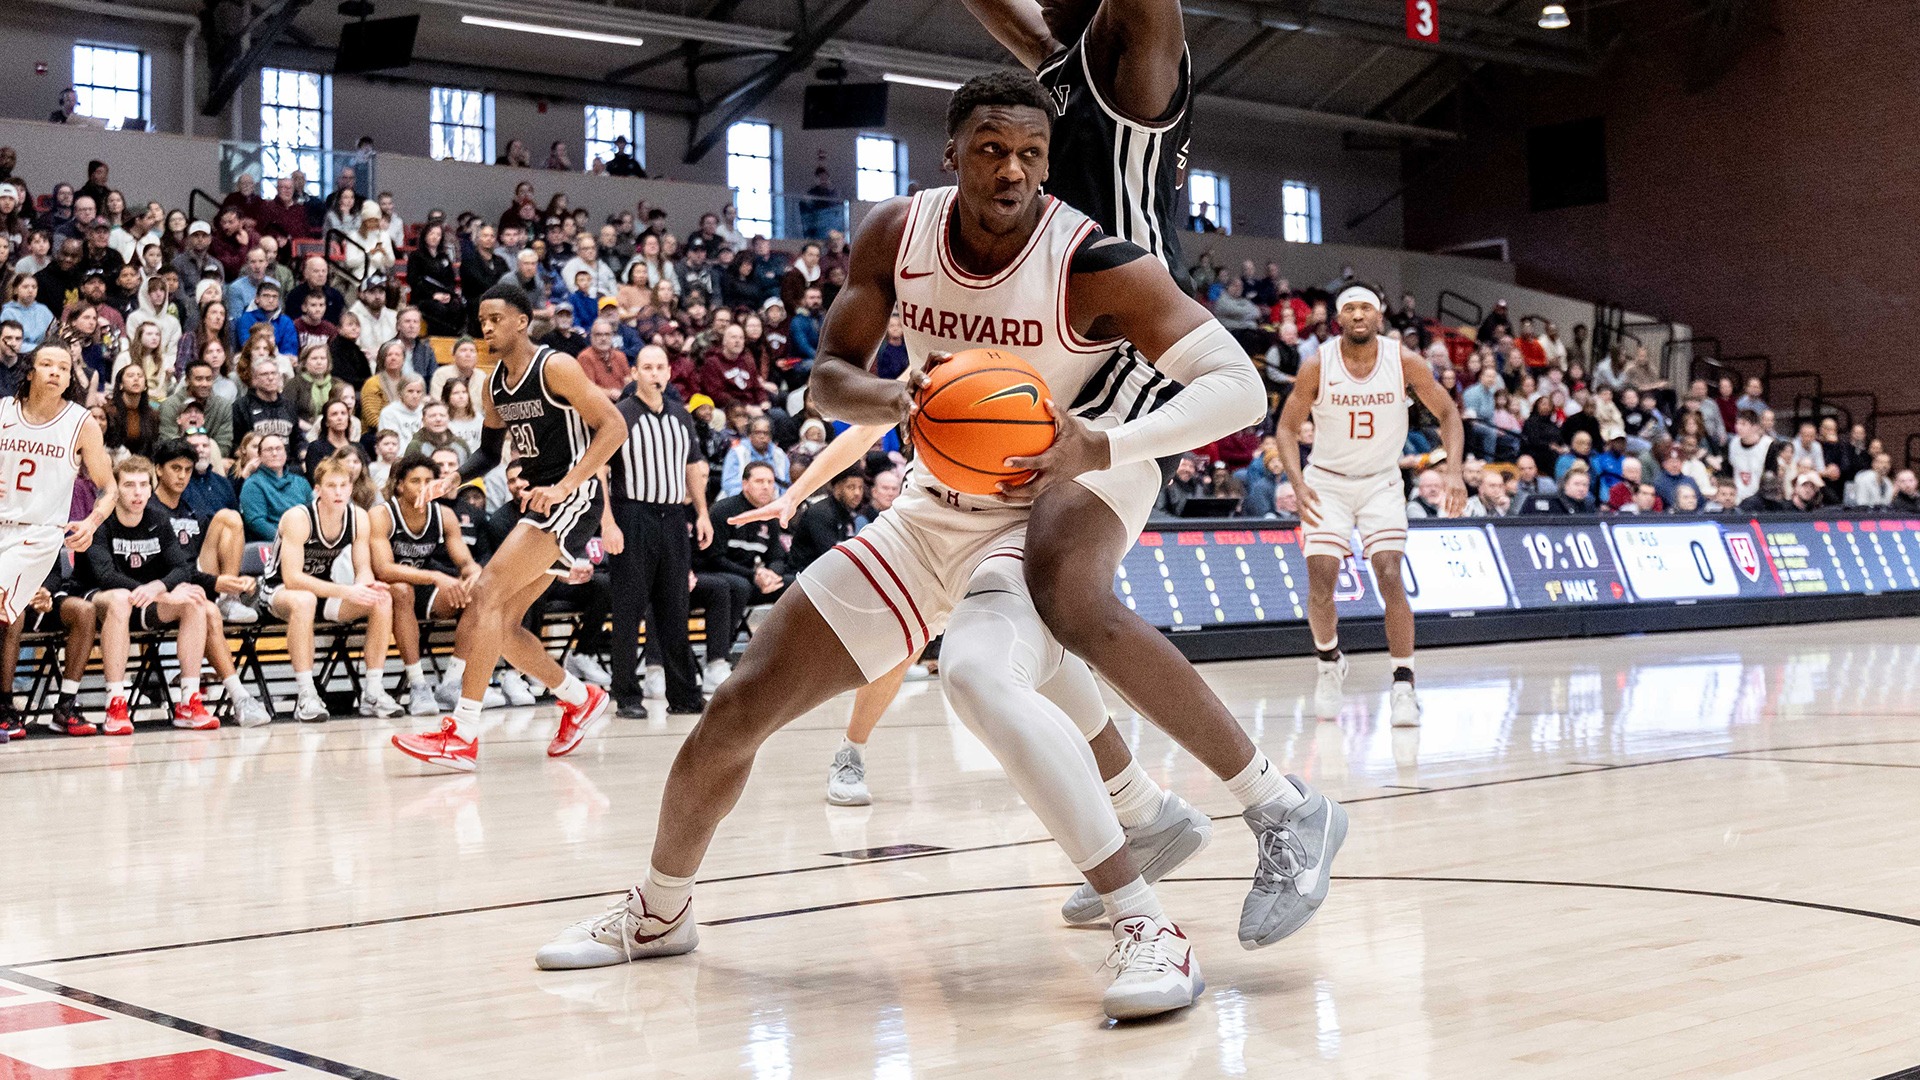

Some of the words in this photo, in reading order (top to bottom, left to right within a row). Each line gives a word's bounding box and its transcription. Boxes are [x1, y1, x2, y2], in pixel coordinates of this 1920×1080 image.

[1415, 0, 1434, 37] 3
[901, 300, 1044, 348] HARVARD
[1330, 392, 1396, 407] HARVARD
[510, 422, 540, 458] 21
[1348, 411, 1375, 440] 13
[0, 438, 66, 459] HARVARD
[16, 458, 37, 493] 2
[946, 490, 960, 508] H
[1521, 531, 1599, 570] 19:10
[1689, 540, 1715, 586] 0
[1730, 540, 1756, 568] H
